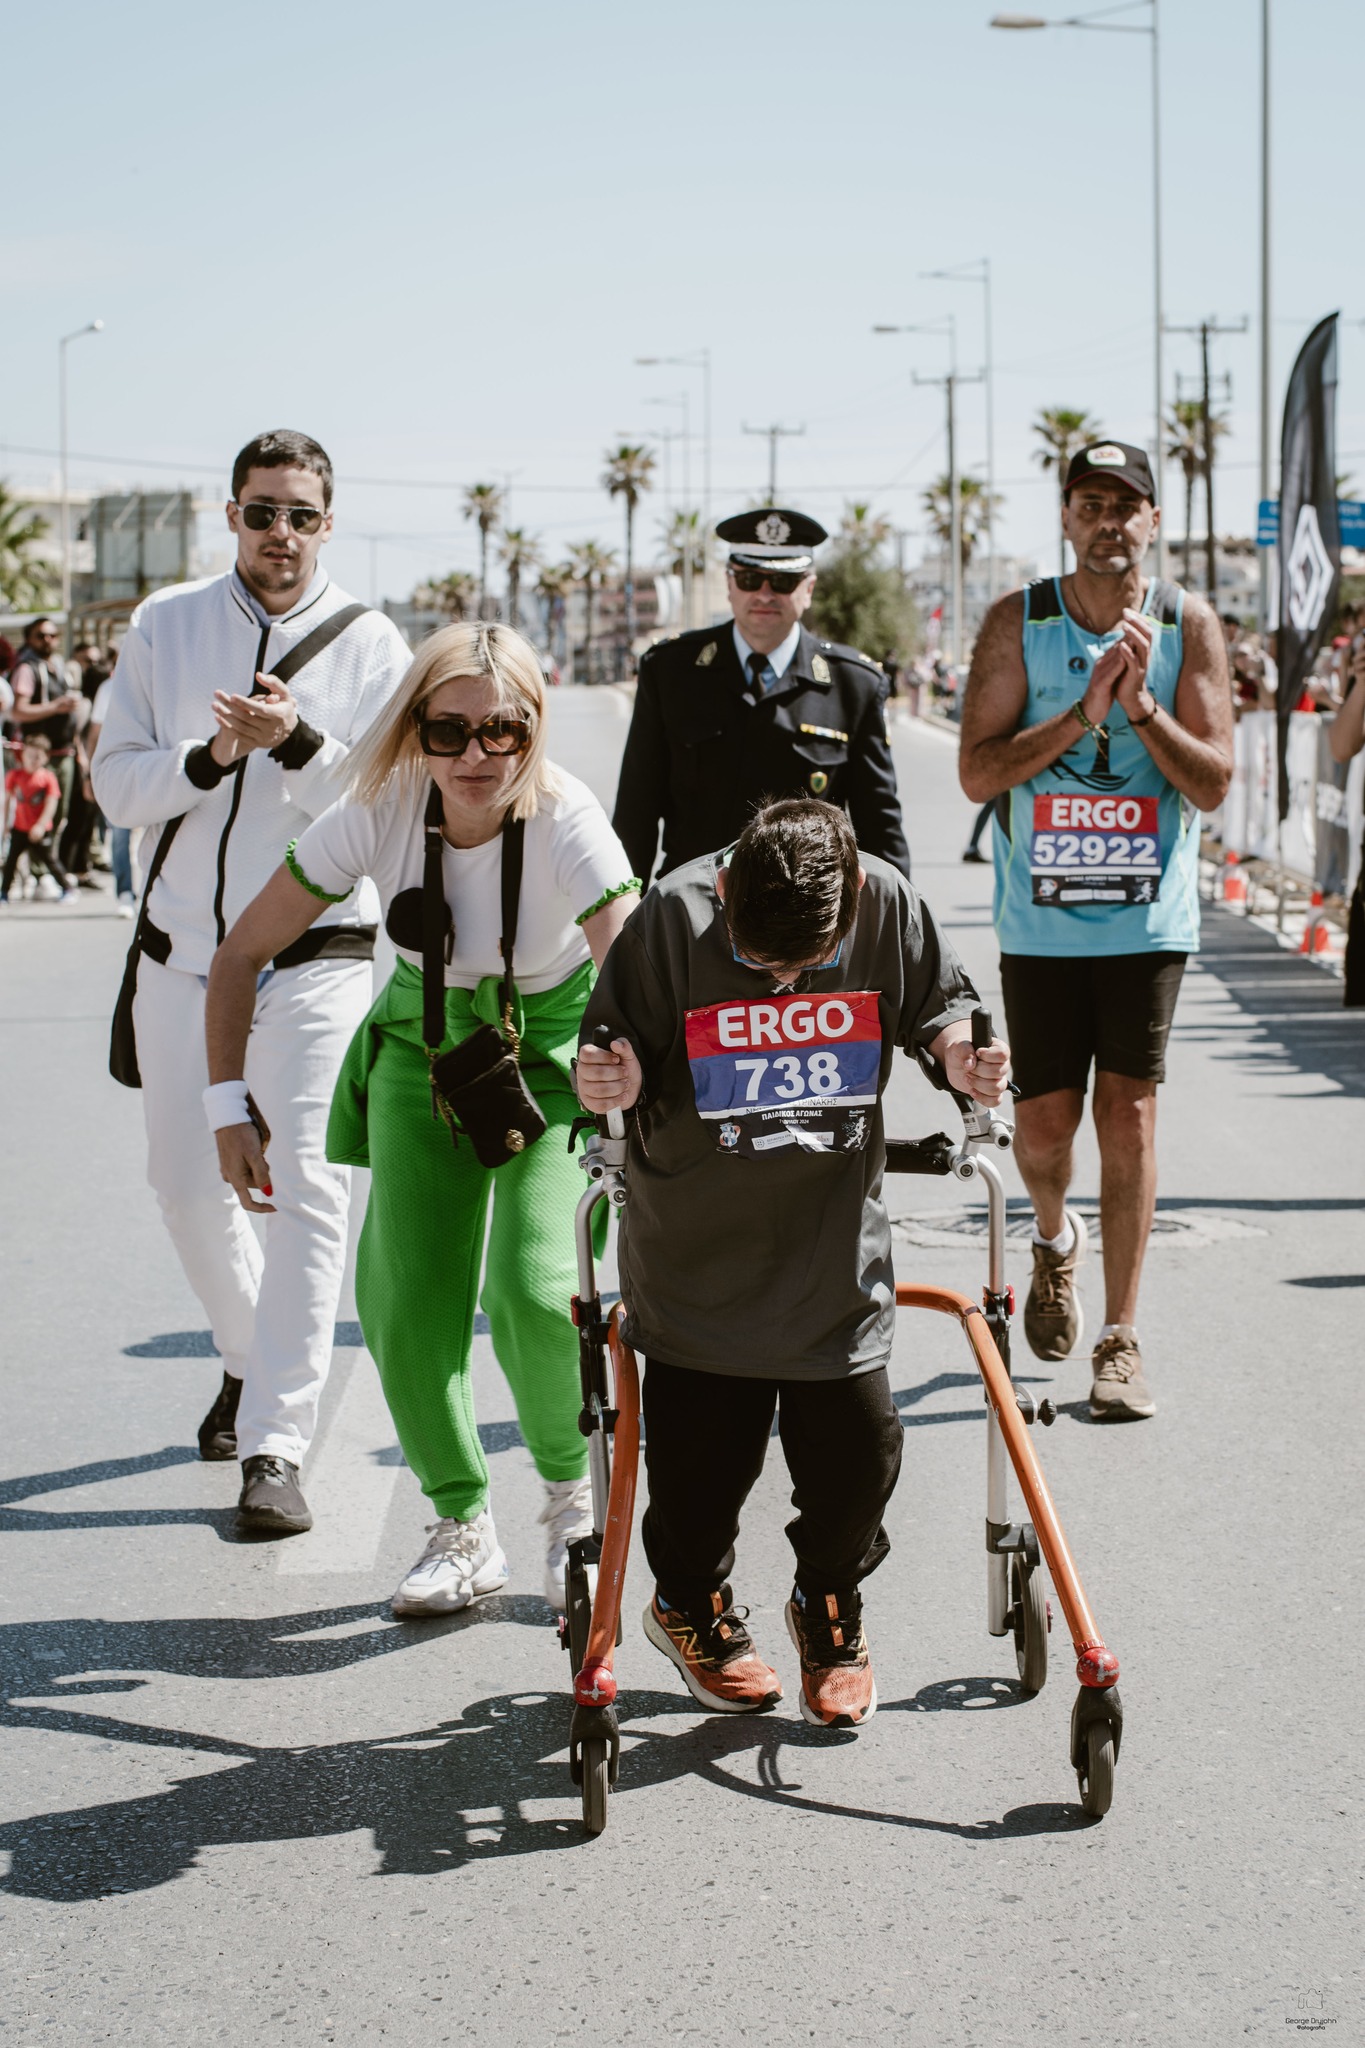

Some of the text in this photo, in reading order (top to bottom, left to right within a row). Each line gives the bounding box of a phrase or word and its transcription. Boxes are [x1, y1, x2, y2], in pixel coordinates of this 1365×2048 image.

[1051, 798, 1142, 829] ERGO
[1033, 834, 1158, 865] 52922
[717, 1000, 854, 1047] ERGO
[735, 1051, 842, 1101] 738
[795, 1109, 823, 1117] ΑΓΩΝΑΣ
